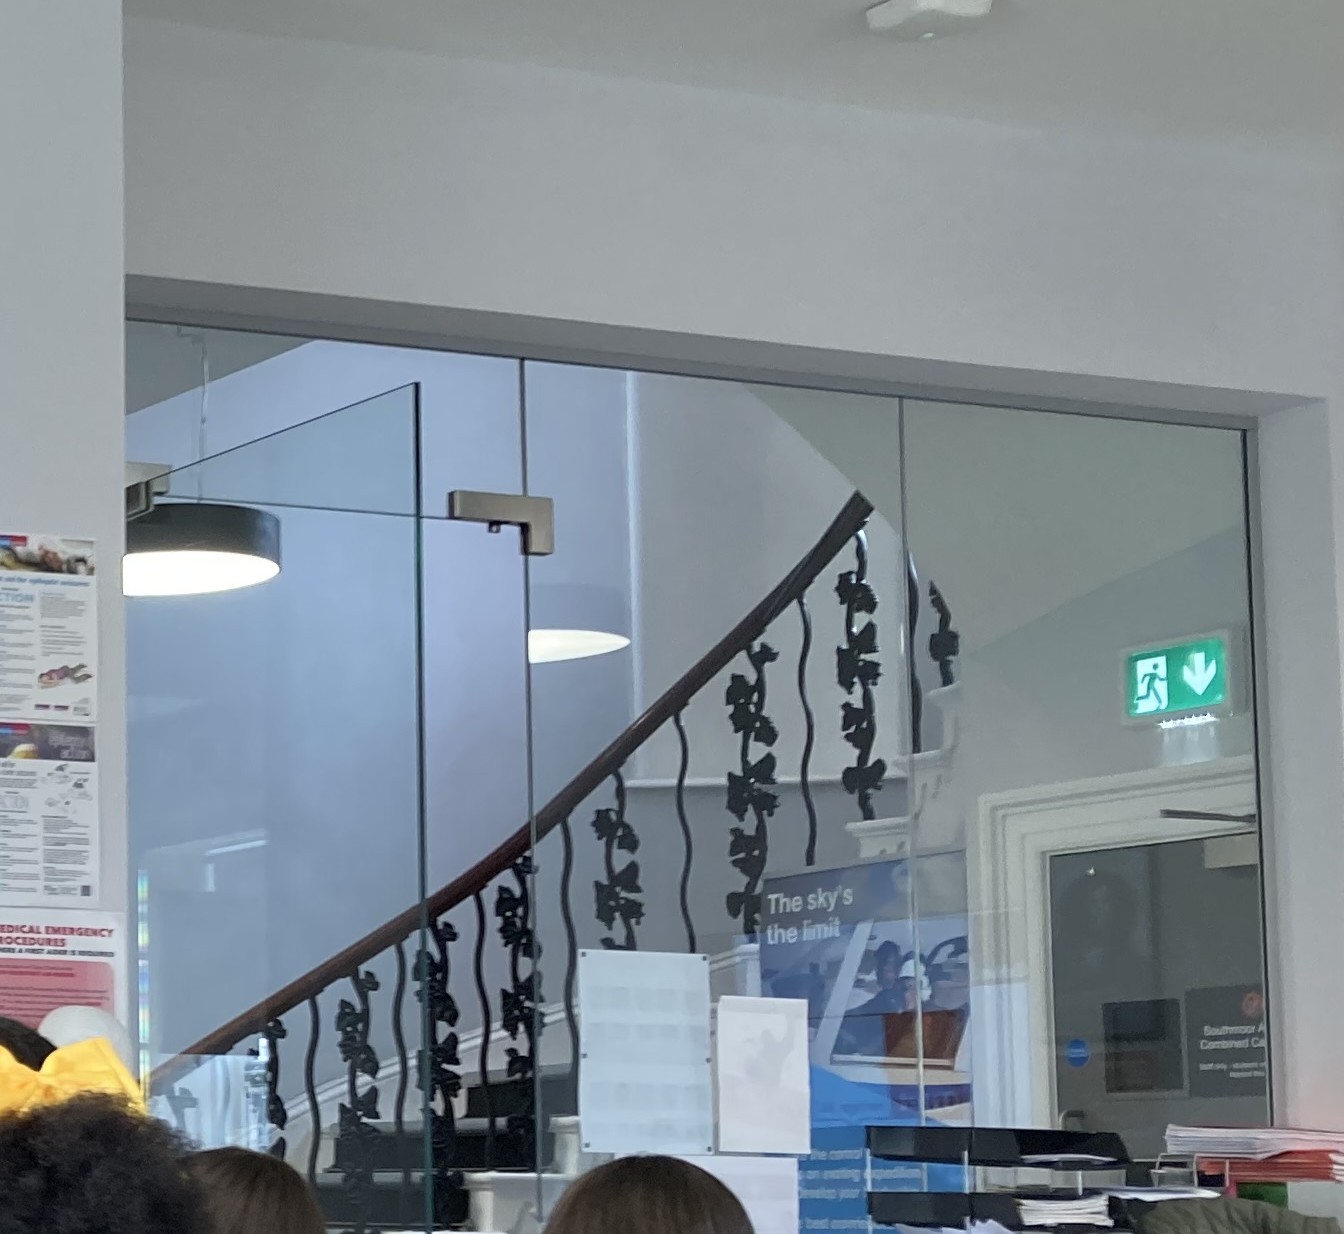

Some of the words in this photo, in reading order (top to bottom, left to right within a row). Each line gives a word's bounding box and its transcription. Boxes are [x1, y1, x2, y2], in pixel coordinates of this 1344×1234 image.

[768, 892, 805, 916] The
[806, 885, 854, 913] sky's
[44, 926, 115, 938] EMERGENCY
[766, 923, 798, 945] the
[802, 916, 841, 943] limit
